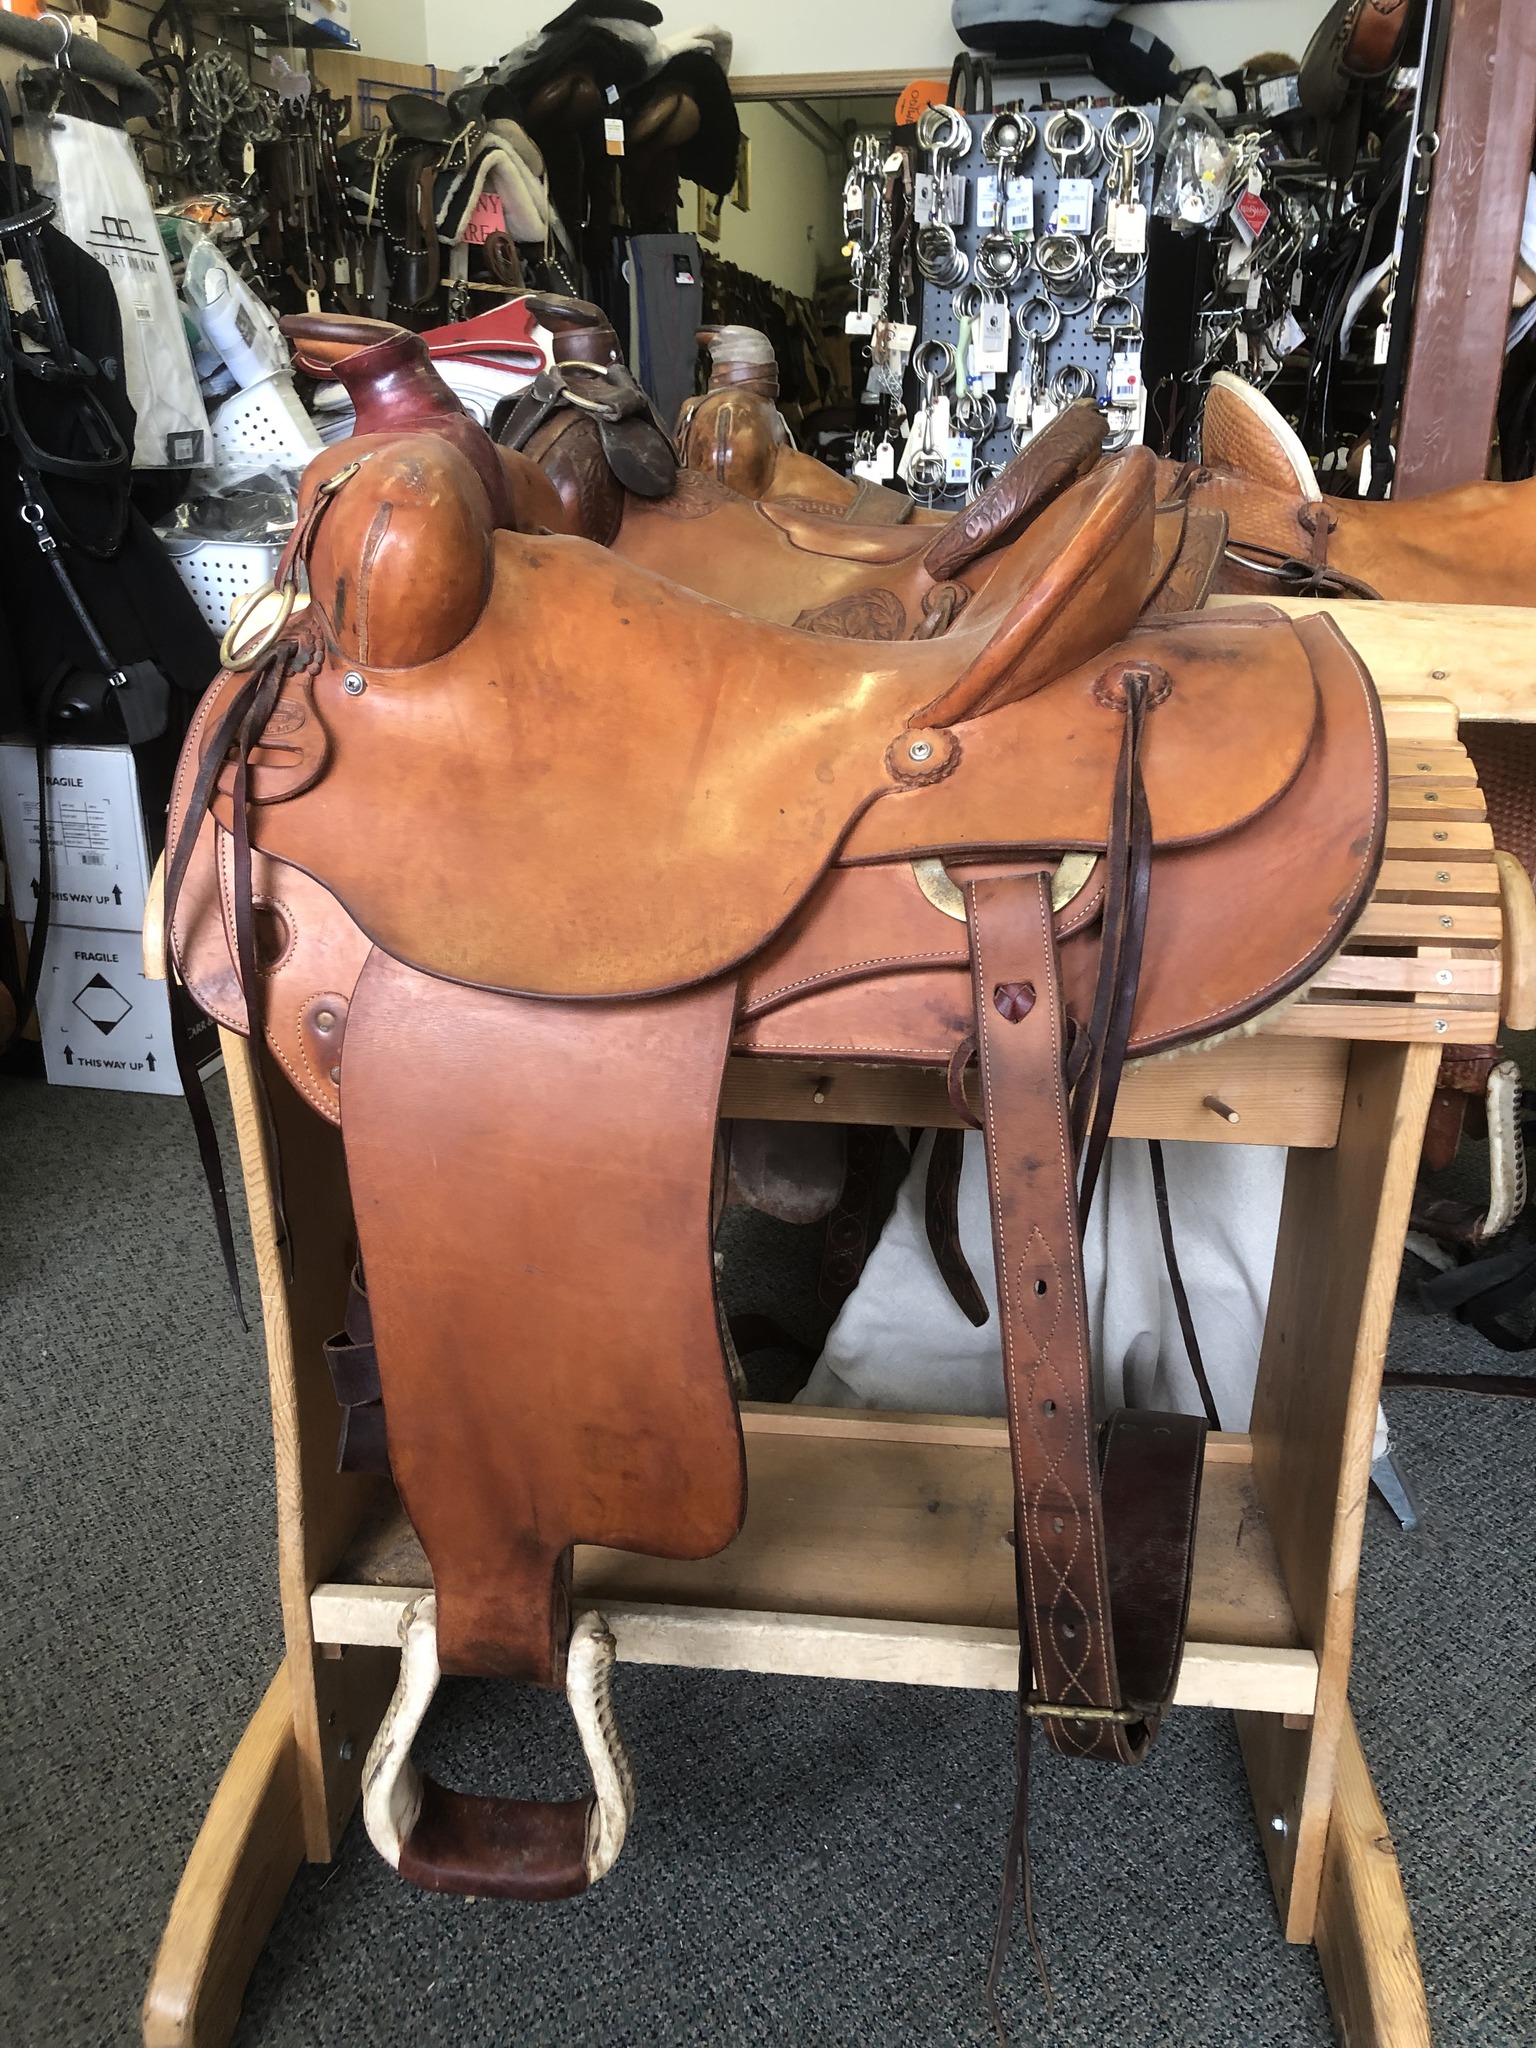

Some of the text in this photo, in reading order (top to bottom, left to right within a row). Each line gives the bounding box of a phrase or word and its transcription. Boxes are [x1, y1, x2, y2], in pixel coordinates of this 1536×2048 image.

[45, 776, 84, 788] RAGILE
[50, 891, 110, 905] HIS WAY UP
[74, 951, 119, 963] FRAGILE
[78, 1057, 144, 1071] THIS WAY UP
